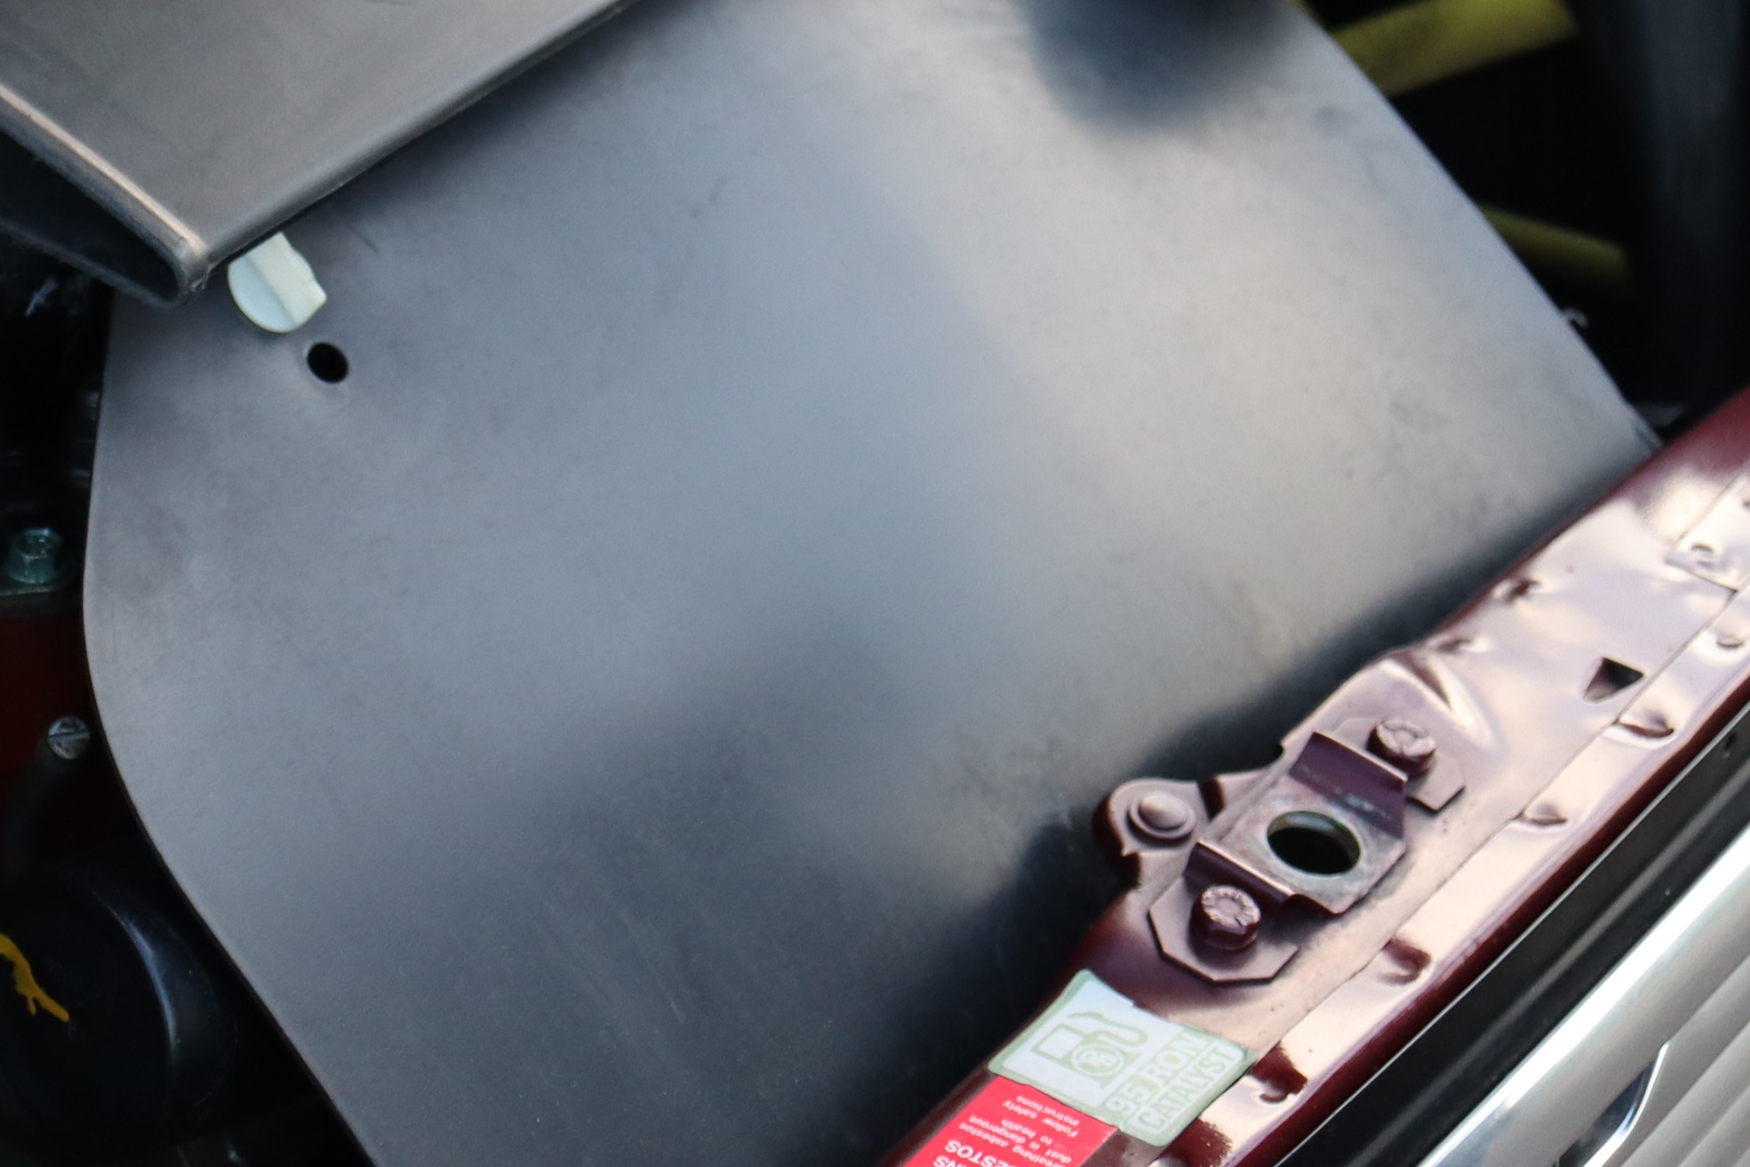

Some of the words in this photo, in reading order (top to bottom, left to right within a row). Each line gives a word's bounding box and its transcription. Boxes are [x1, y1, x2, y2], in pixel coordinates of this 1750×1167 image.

[1103, 1081, 1154, 1117] 95
[1138, 1031, 1209, 1086] RON
[1134, 1044, 1237, 1129] CATALYST
[1002, 1099, 1038, 1120] safety
[1016, 1095, 1080, 1126] instructions
[959, 1123, 1009, 1148] asbestos
[968, 1115, 1026, 1144] dangerous
[1001, 1119, 1036, 1138] health
[1042, 1118, 1079, 1138] Follow
[1040, 1136, 1053, 1146] to
[1045, 1149, 1072, 1164] dust
